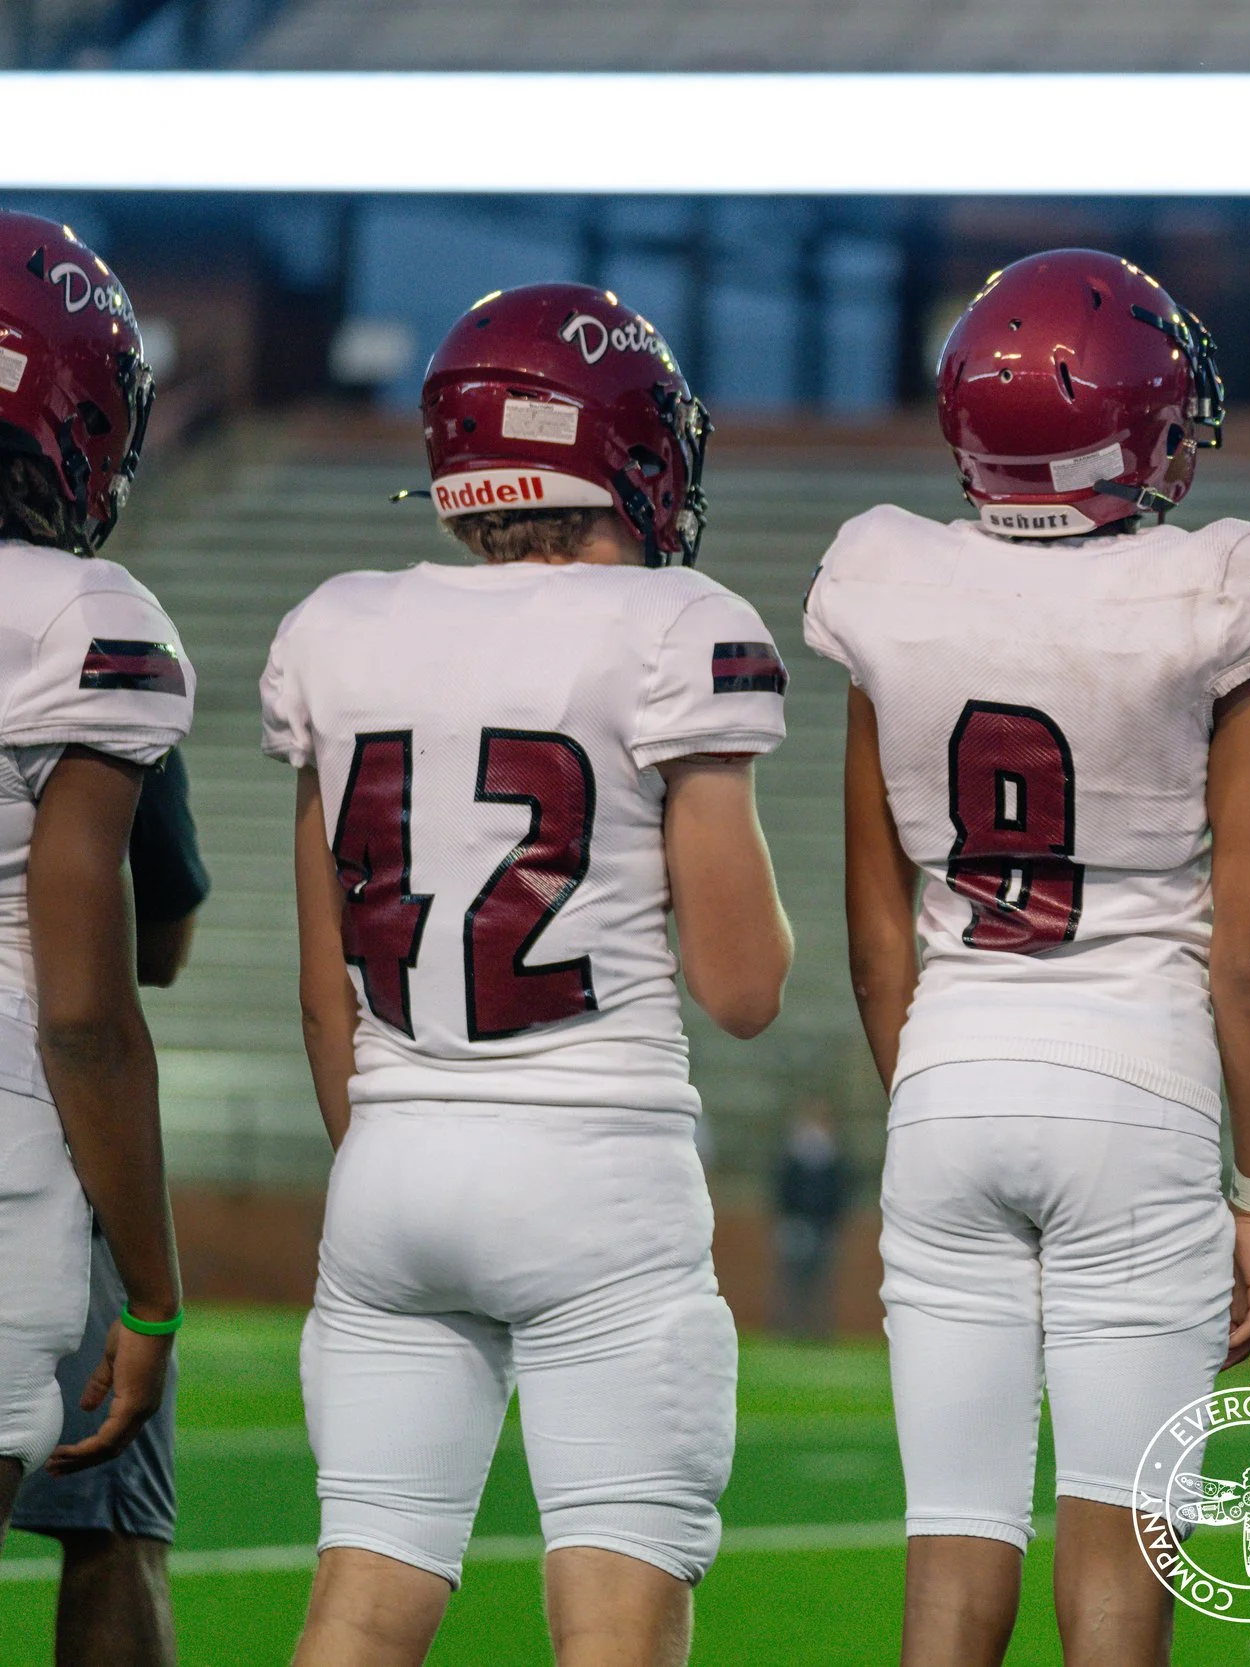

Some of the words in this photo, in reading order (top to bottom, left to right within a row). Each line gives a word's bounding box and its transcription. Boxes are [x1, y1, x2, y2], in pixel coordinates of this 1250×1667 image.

[436, 476, 544, 511] Riddell
[333, 727, 600, 1043] 42
[946, 698, 1086, 954] 8
